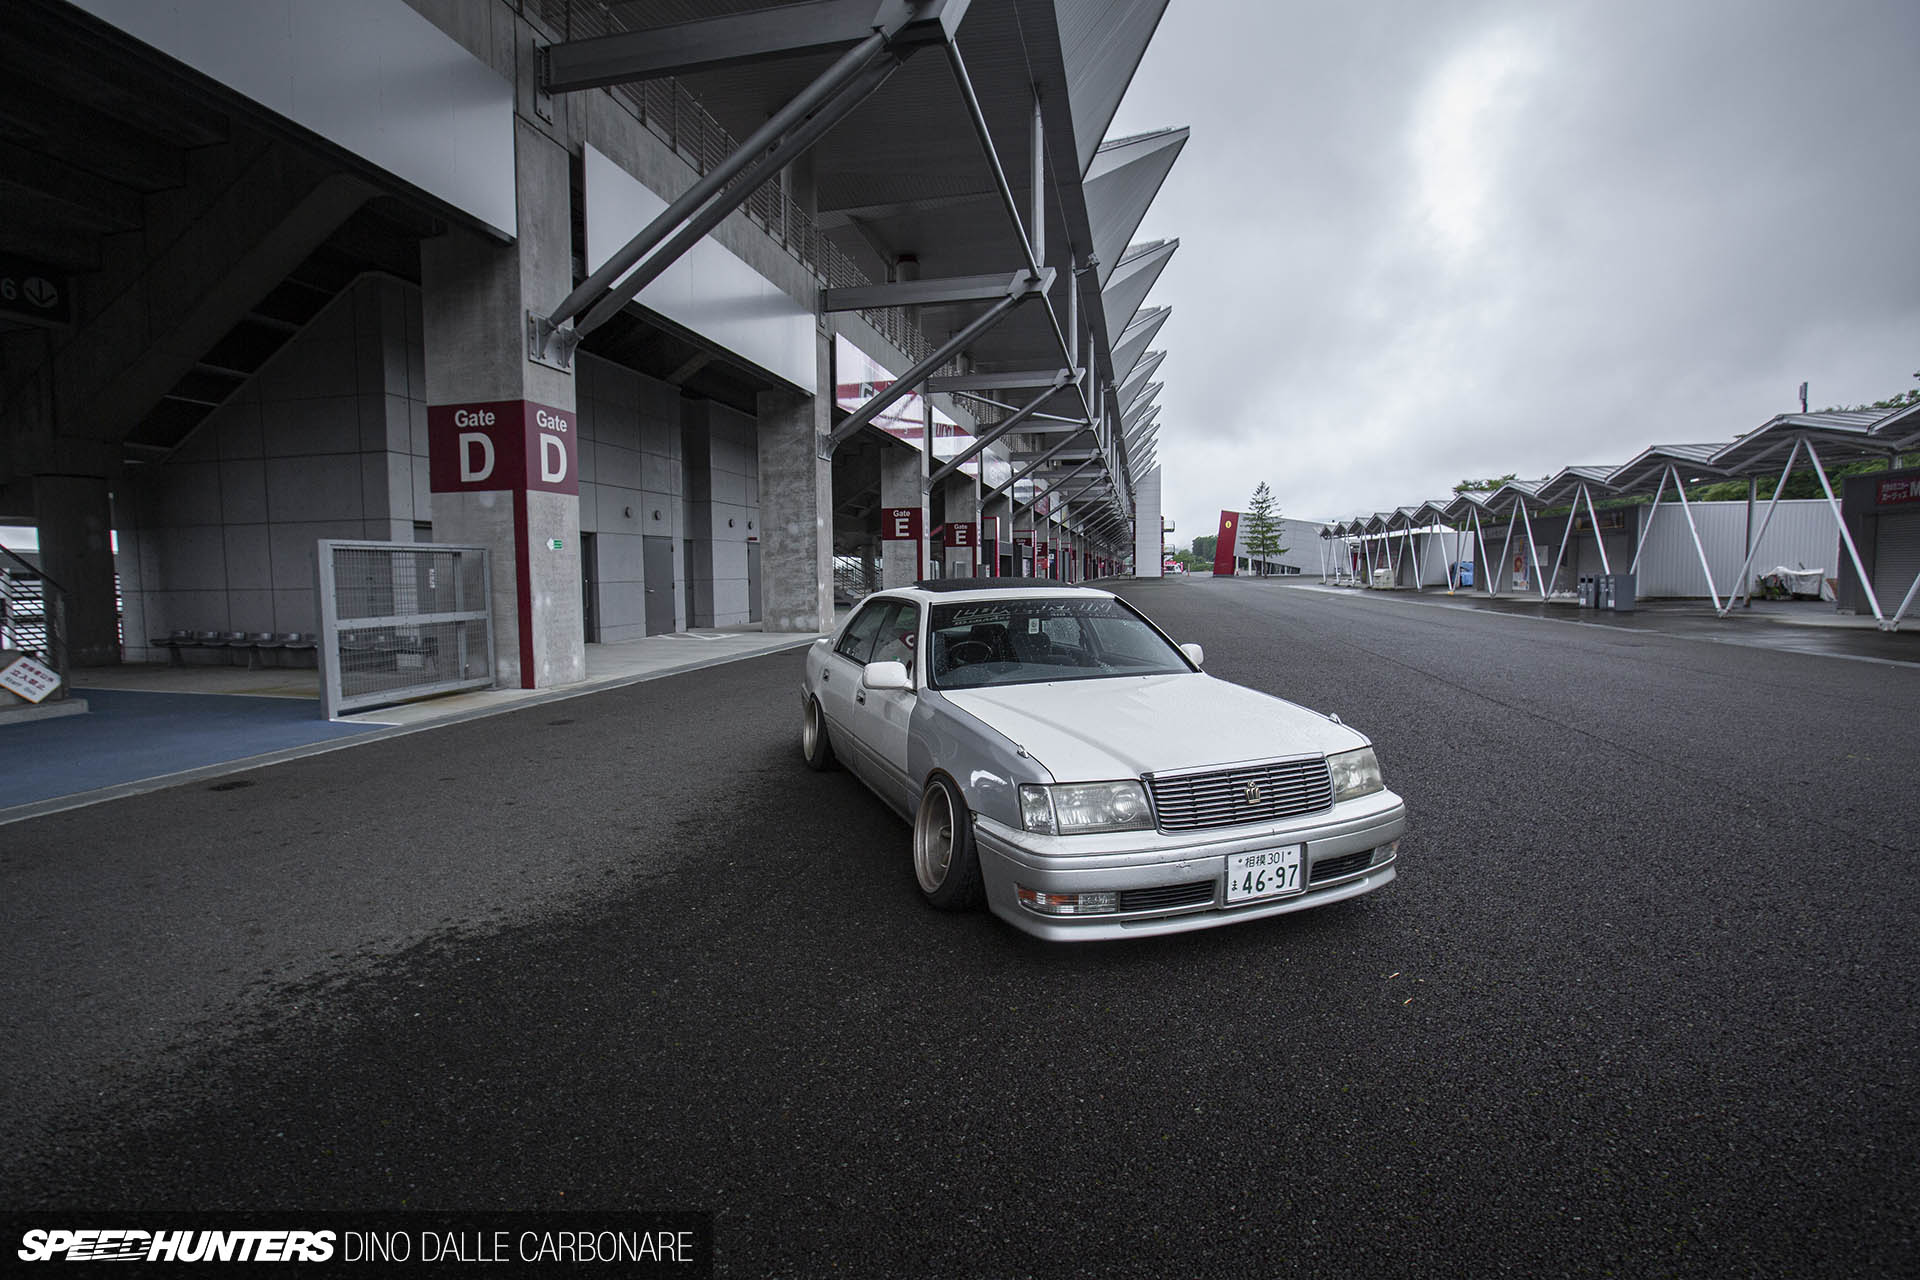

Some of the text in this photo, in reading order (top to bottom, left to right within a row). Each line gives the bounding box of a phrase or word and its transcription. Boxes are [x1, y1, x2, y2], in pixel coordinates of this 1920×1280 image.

[455, 409, 495, 427] Gate
[536, 410, 568, 432] Gate
[459, 432, 495, 482] D
[540, 433, 568, 483] D
[893, 510, 911, 518] Gate
[895, 518, 910, 537] E
[955, 530, 967, 545] E
[1267, 851, 1285, 865] 301
[1242, 864, 1299, 894] 46-97
